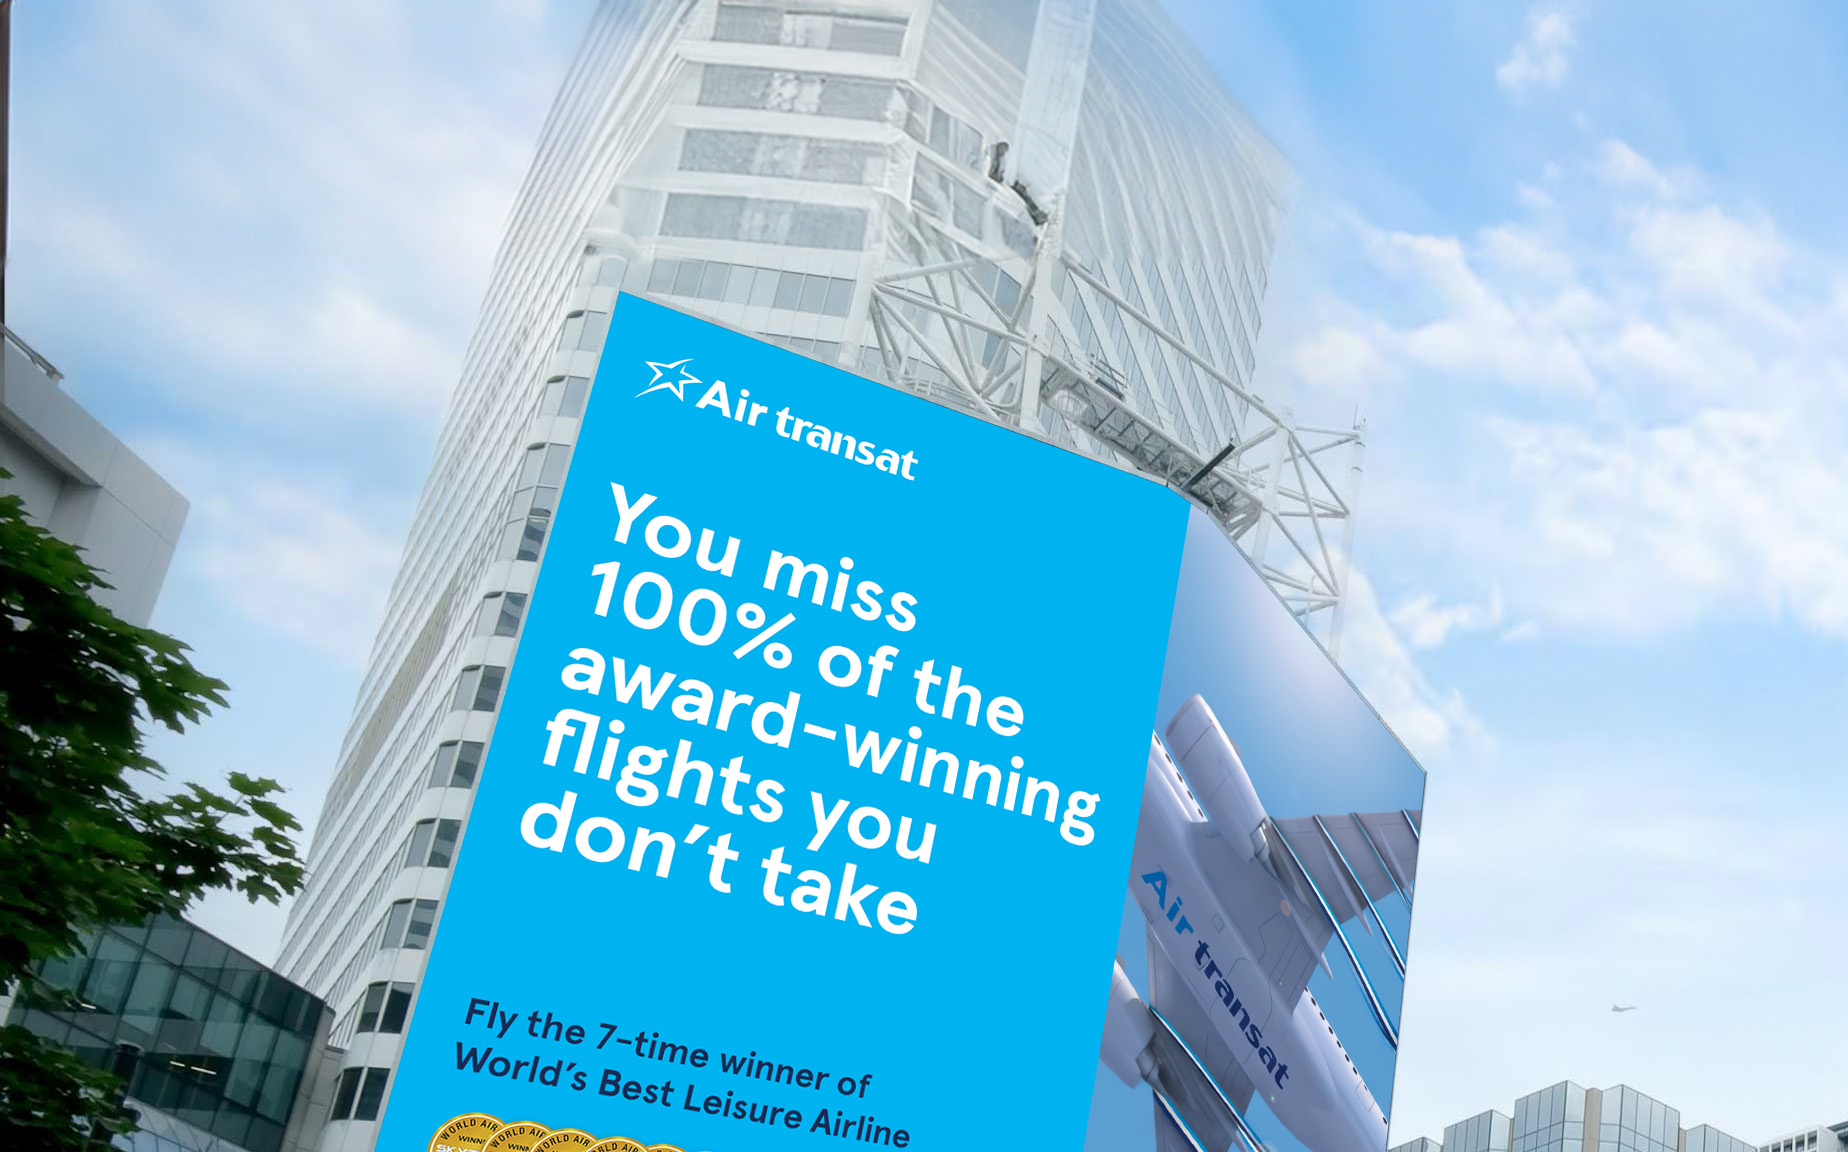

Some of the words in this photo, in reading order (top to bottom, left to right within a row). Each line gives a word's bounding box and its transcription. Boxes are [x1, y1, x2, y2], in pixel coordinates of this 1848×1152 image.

[696, 380, 768, 426] Air
[776, 407, 918, 480] transat
[611, 482, 740, 577] You
[763, 550, 917, 631] miss
[592, 561, 796, 668] 100%
[819, 645, 899, 697] of
[914, 660, 1023, 736] the
[541, 709, 785, 822] flights
[807, 791, 936, 864] you
[561, 648, 1100, 845] award-winning
[761, 847, 917, 934] take
[1141, 871, 1194, 935] Air
[1195, 940, 1290, 1090] transat
[465, 998, 518, 1038] Fly
[528, 1011, 585, 1044] the
[597, 1023, 708, 1067] 7-time
[721, 1051, 830, 1090] winner
[838, 1074, 872, 1098] of
[441, 1119, 476, 1140] WORLD
[491, 1127, 525, 1148] WORLD
[599, 1069, 674, 1107] Best
[684, 1084, 801, 1130] Leisure
[812, 1107, 910, 1149] Airline
